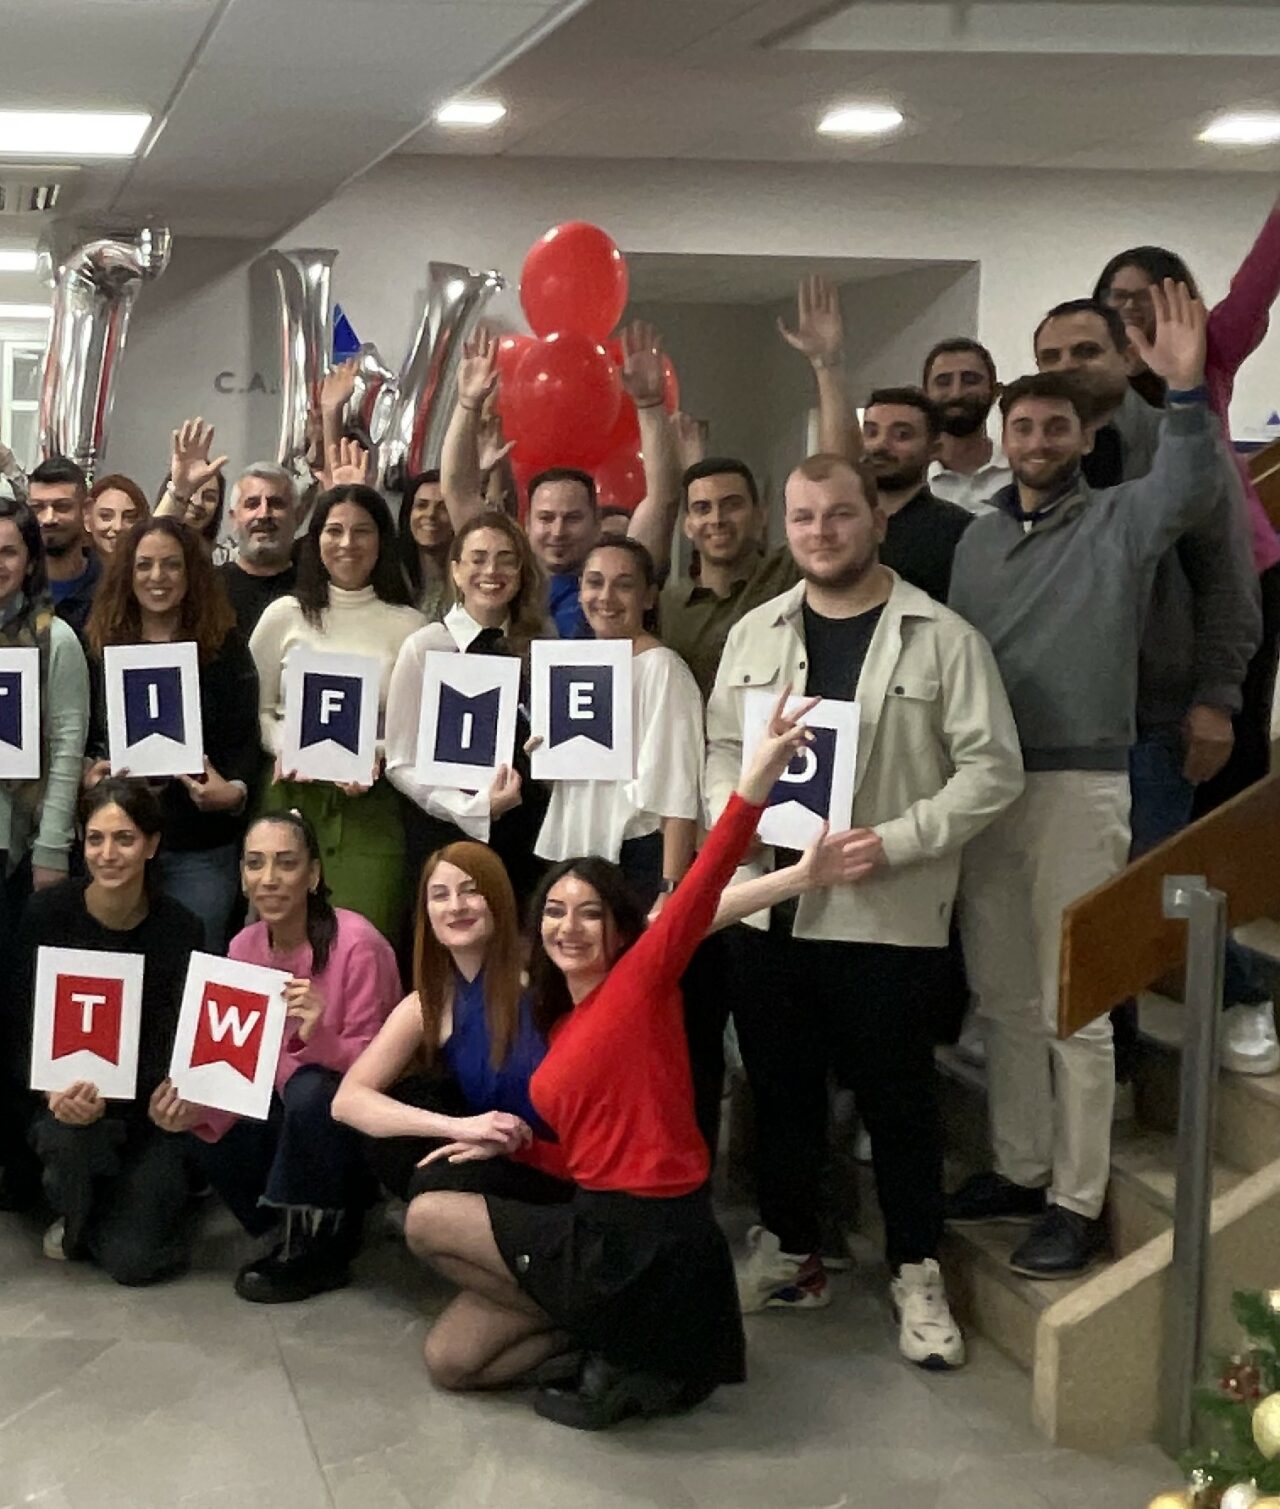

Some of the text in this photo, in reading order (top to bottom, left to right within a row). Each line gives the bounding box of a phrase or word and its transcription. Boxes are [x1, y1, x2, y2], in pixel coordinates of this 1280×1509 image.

[36, 215, 172, 485] T
[147, 683, 159, 719] I
[321, 690, 344, 724] F
[569, 682, 594, 719] E
[460, 712, 473, 749] I
[72, 994, 106, 1032] T
[208, 1000, 260, 1047] W
